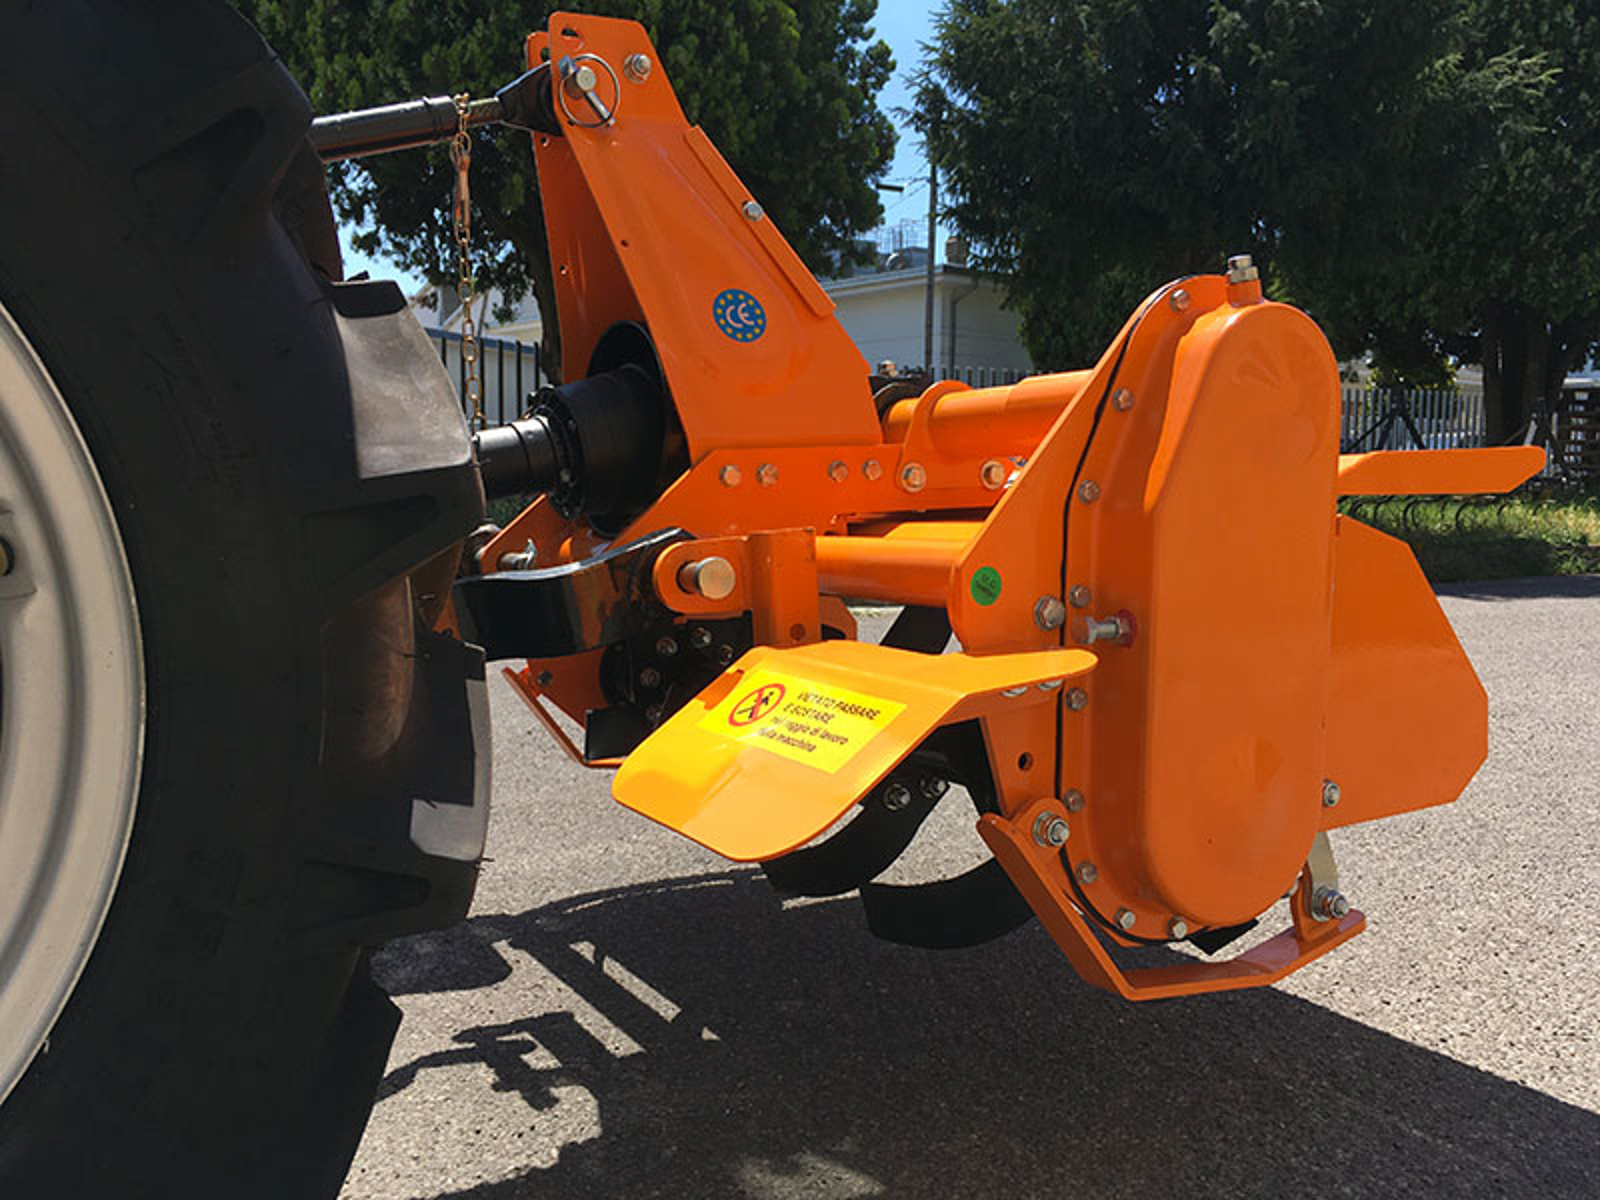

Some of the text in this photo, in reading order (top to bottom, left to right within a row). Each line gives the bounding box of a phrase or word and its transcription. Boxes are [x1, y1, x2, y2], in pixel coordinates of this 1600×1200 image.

[783, 702, 835, 724] E SOSTARE
[834, 701, 880, 720] PASSARE
[776, 733, 817, 752] macchina
[809, 727, 821, 736] di
[819, 728, 849, 744] lavoro
